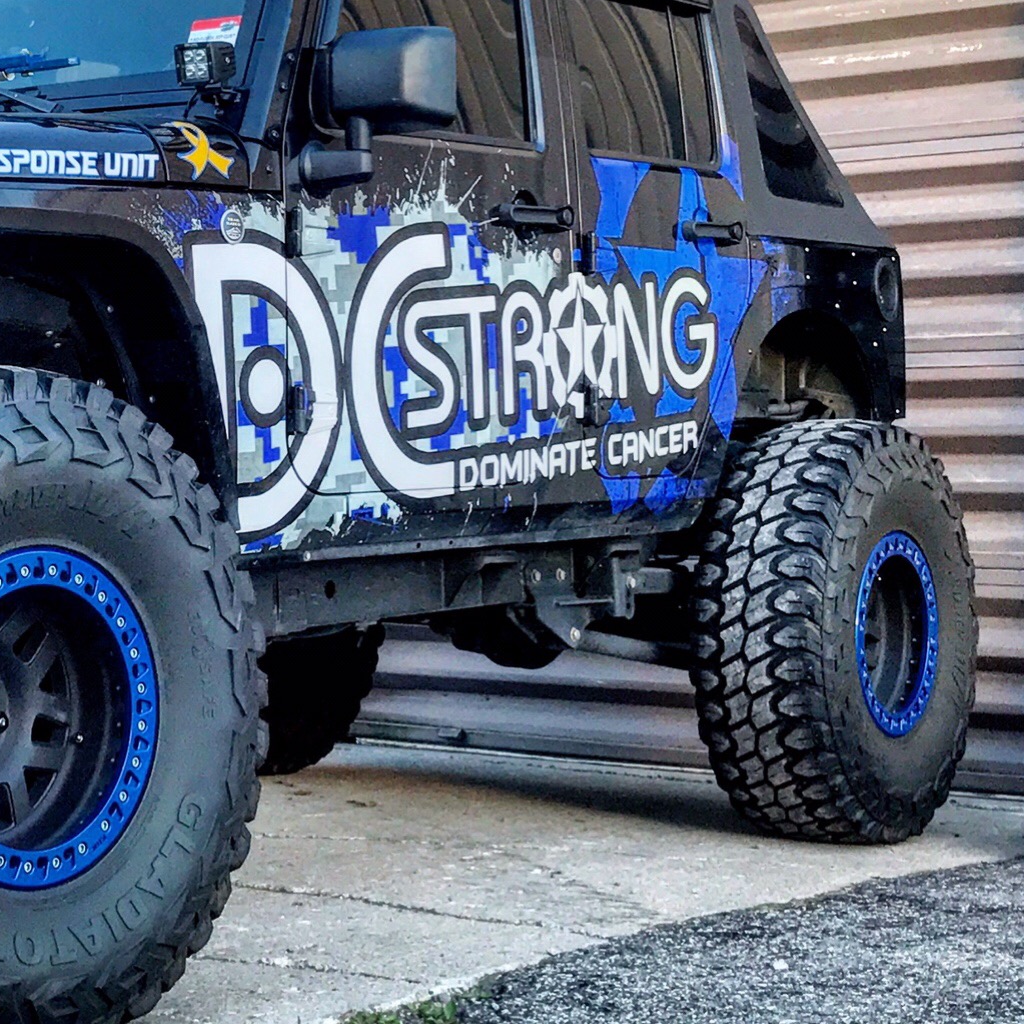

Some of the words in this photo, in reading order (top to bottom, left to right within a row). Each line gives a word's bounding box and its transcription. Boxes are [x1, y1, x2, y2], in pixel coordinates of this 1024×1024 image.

[103, 153, 159, 179] UNIT
[406, 272, 714, 429] STRONG
[459, 438, 597, 492] DOMINATE
[608, 420, 698, 467] CANCER
